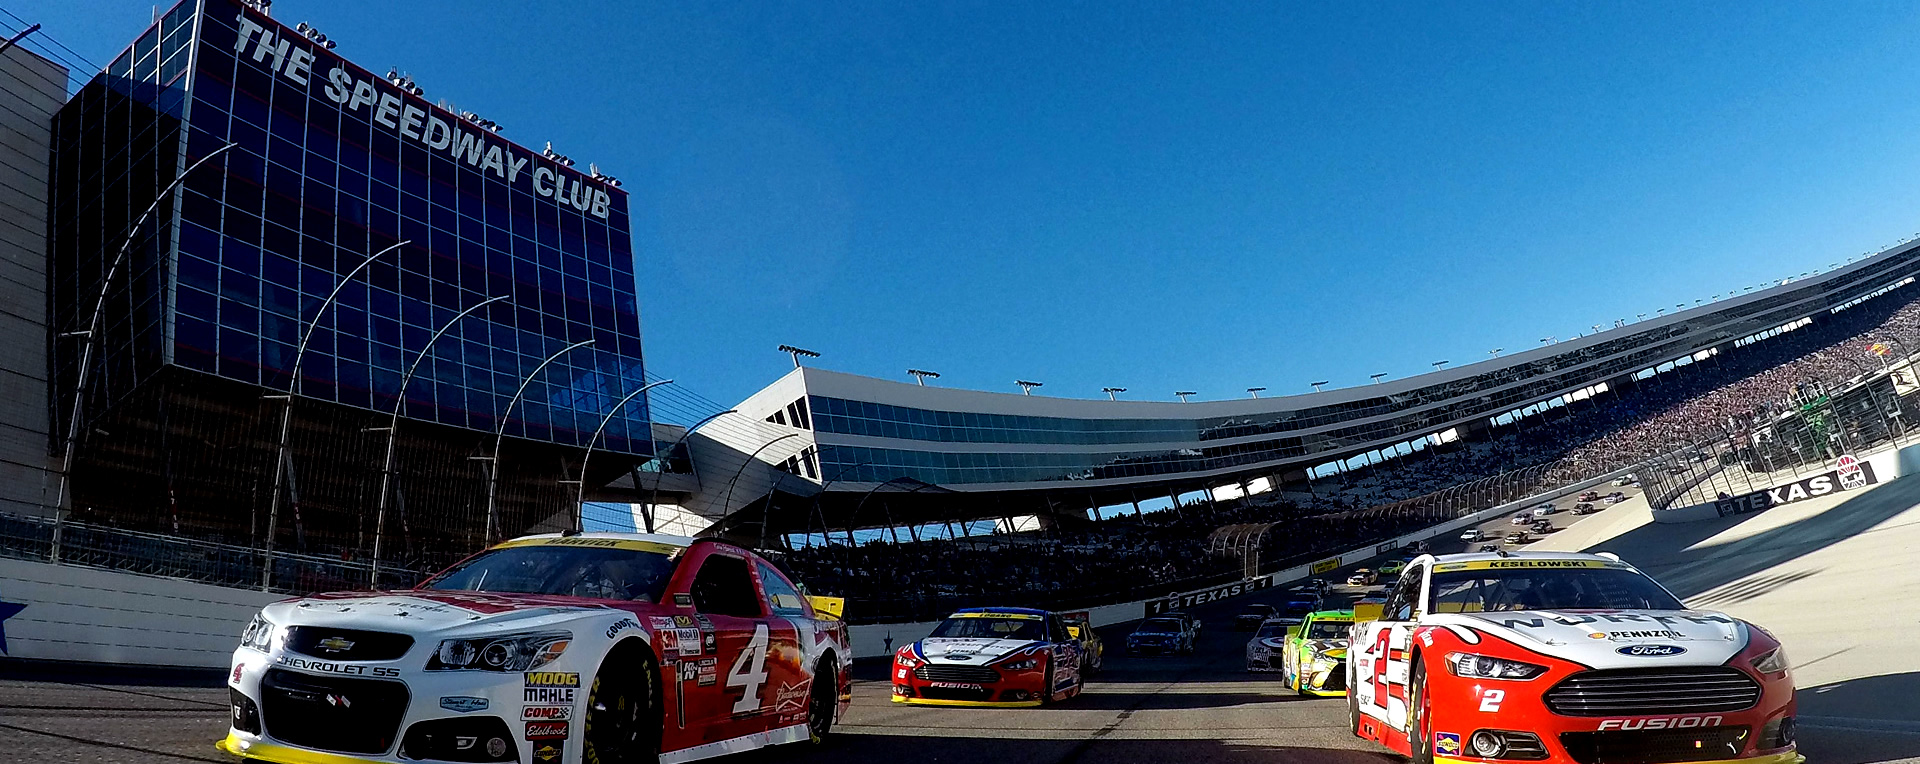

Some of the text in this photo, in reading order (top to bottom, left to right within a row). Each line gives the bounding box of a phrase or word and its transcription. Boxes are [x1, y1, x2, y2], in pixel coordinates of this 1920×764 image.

[234, 14, 611, 219] THE SPEEDWAY CLUB
[1735, 476, 1832, 512] TEXAS
[1489, 560, 1587, 568] KESELOWSKI
[1185, 585, 1240, 606] TEXAS
[662, 629, 679, 648] 3M
[1610, 630, 1686, 638] PENNZOIL
[1630, 644, 1673, 656] Ford
[277, 656, 400, 677] CHEVROLET SS
[726, 624, 769, 714] 4
[526, 673, 578, 685] MOOG
[523, 688, 574, 702] MAHLE
[1479, 689, 1505, 712] 2
[524, 707, 560, 718] COMP
[526, 725, 567, 736] Edelbrock
[1597, 715, 1723, 731] FUSION
